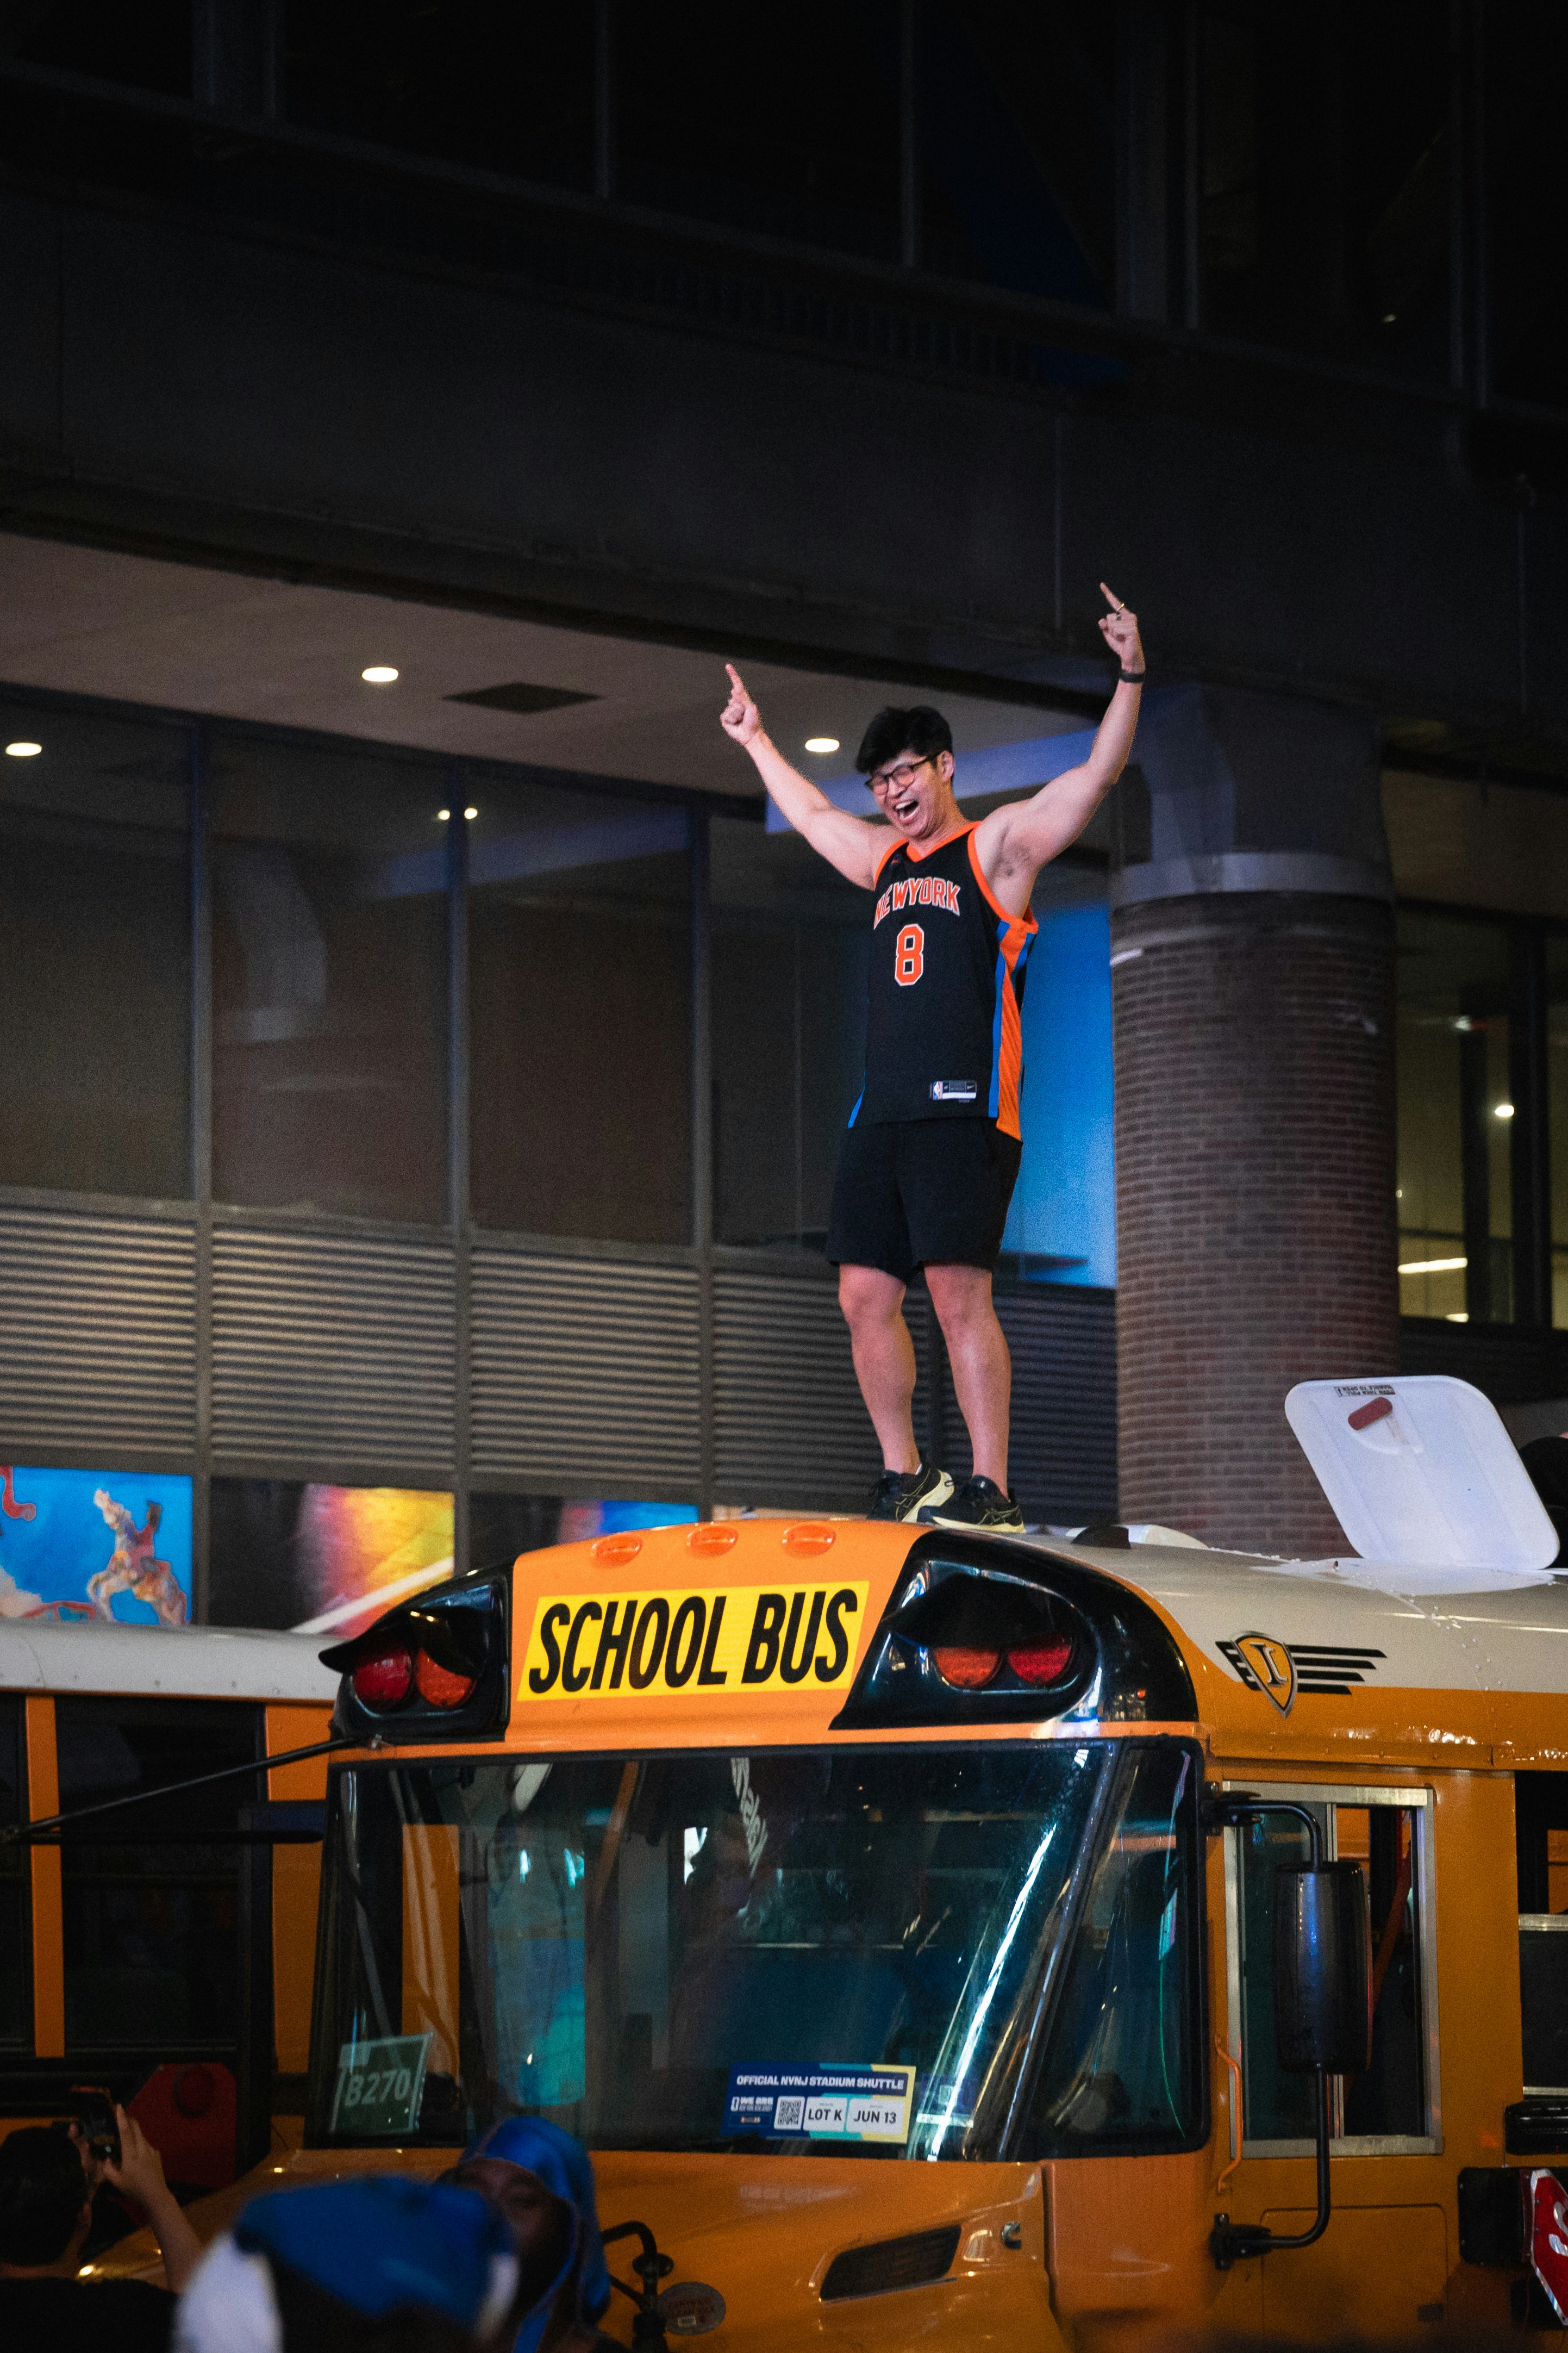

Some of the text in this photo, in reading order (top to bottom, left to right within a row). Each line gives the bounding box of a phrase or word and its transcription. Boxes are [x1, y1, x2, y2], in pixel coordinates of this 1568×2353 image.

[894, 923, 925, 986] 8
[529, 1589, 858, 1694] SCHOOL BUS
[736, 2075, 779, 2086] OFFICIAL
[809, 2076, 855, 2088] STADIUM
[857, 2077, 904, 2090] SHUTTLE
[808, 2108, 842, 2121] LOT K
[853, 2111, 897, 2124] JUN 13
